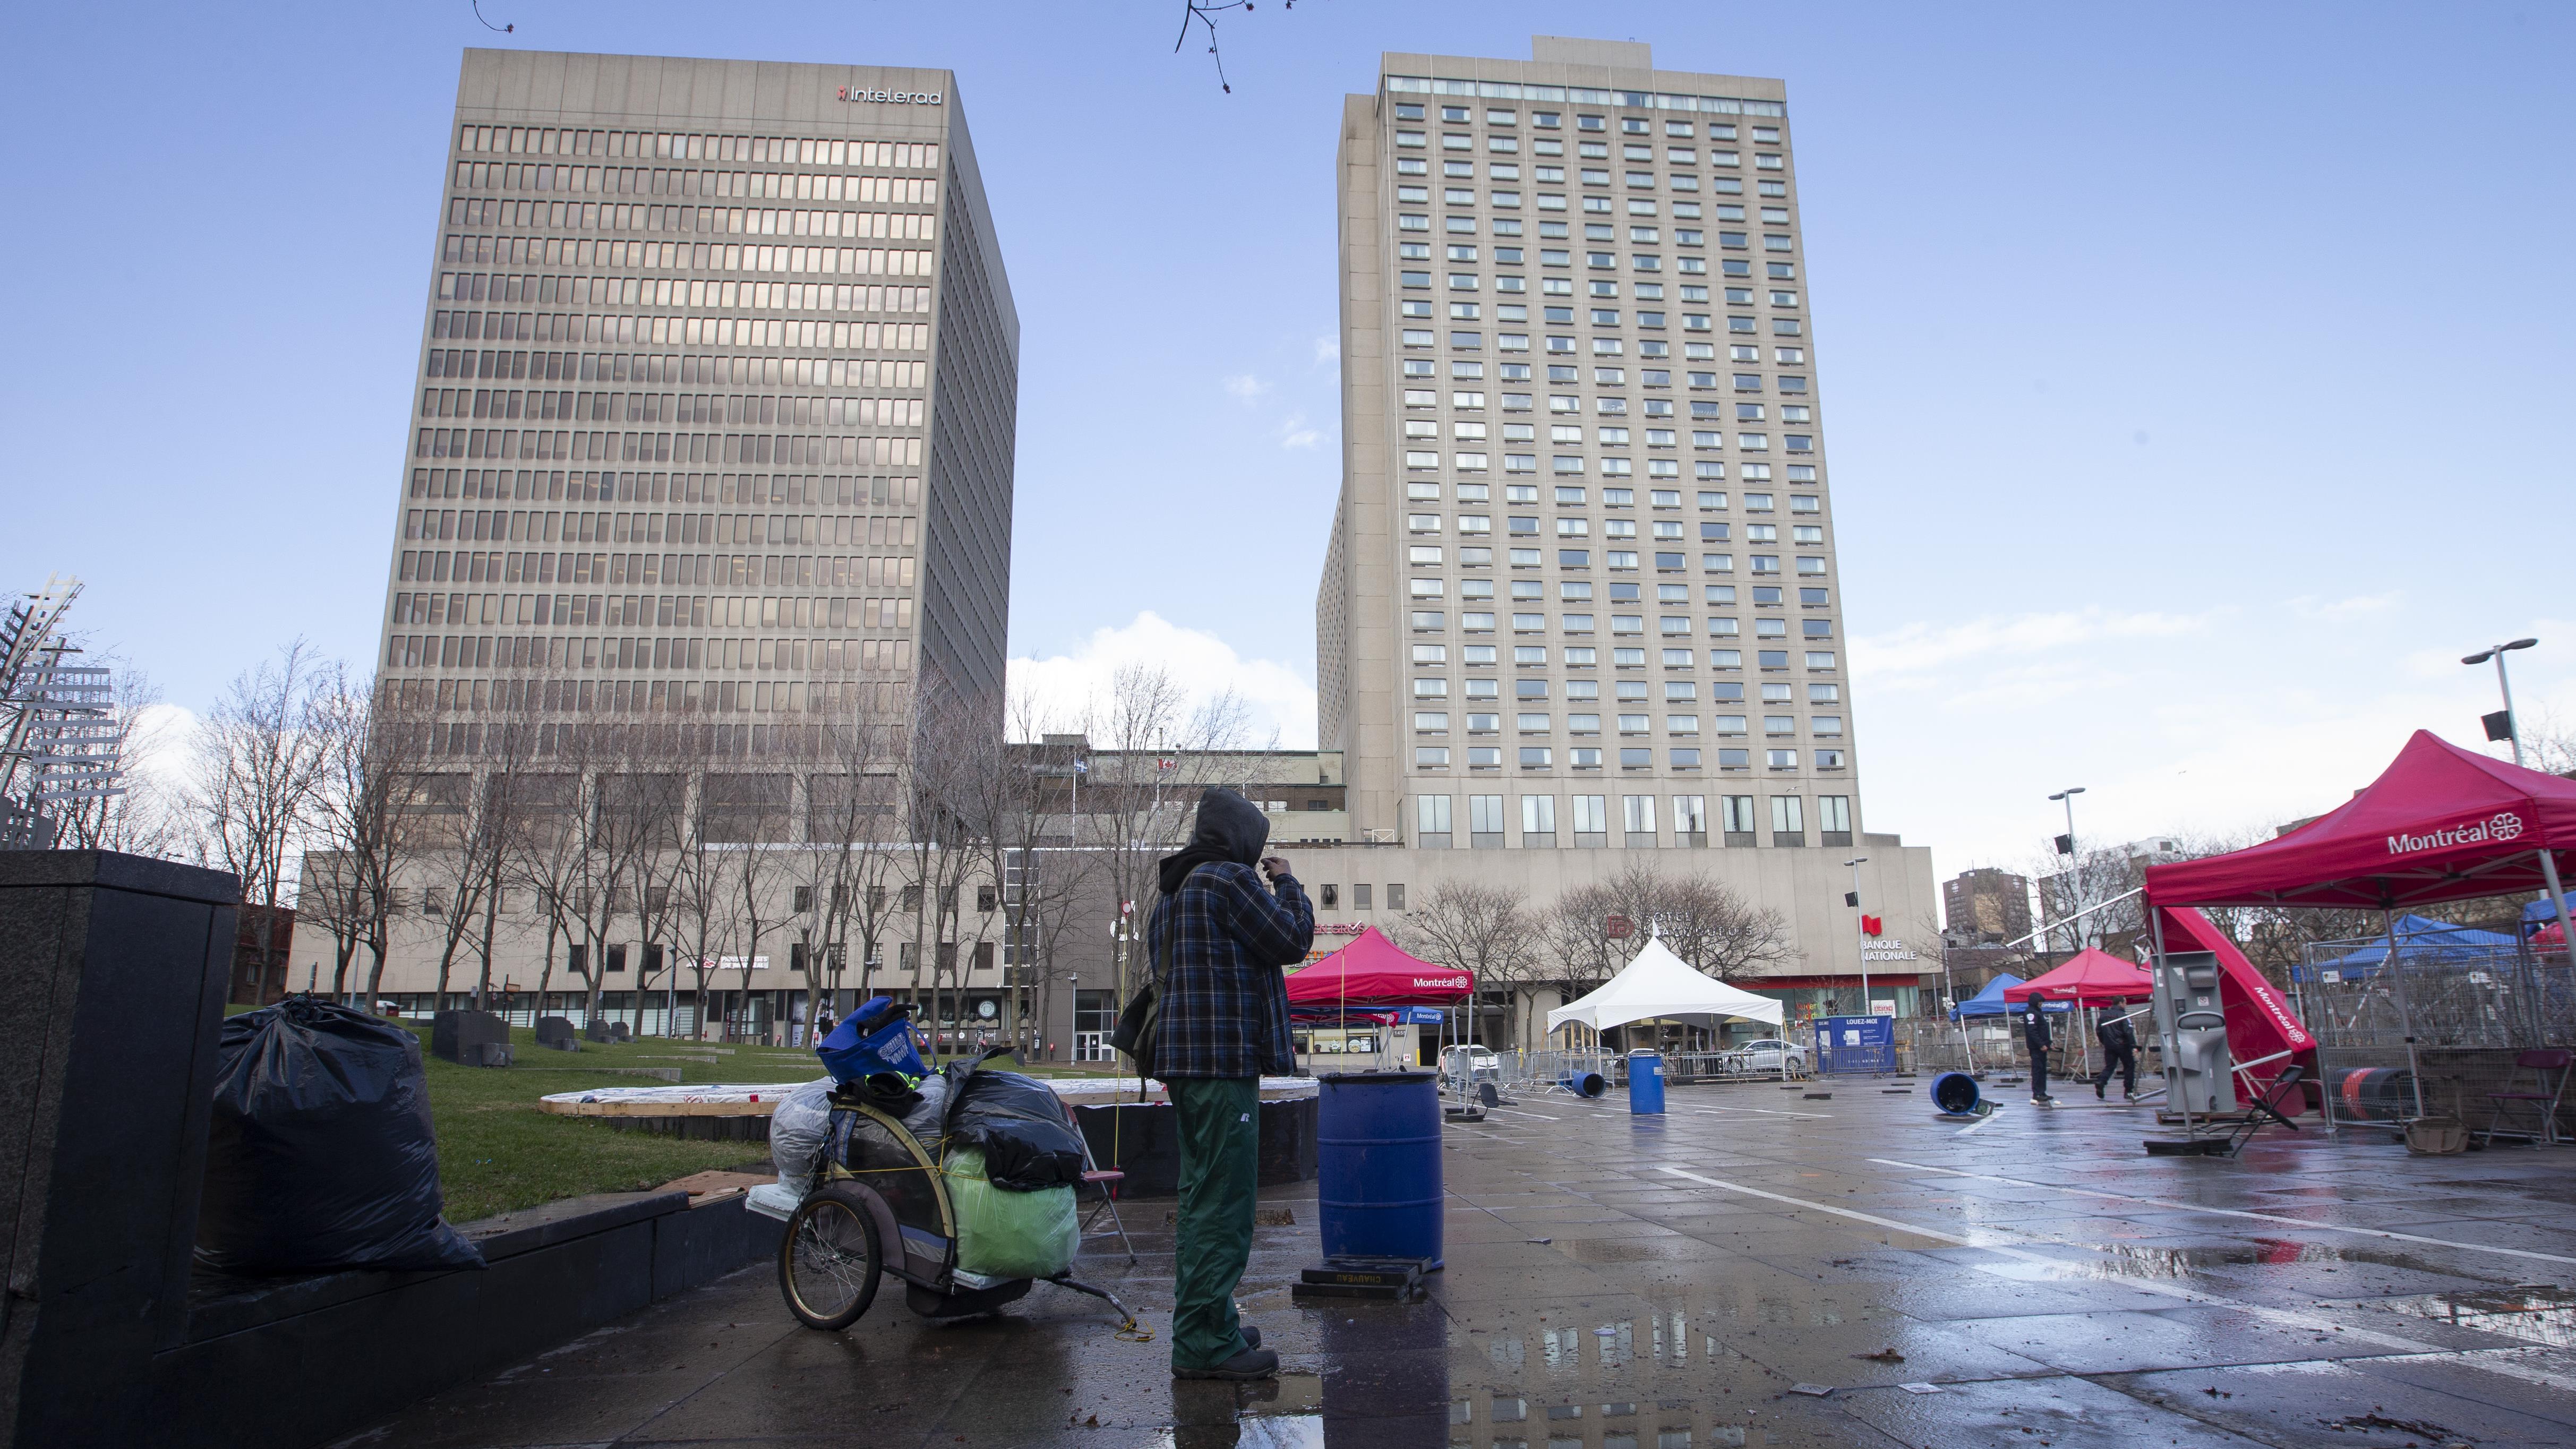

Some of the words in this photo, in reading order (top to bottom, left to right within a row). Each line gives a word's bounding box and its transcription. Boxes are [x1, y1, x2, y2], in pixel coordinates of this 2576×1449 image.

[851, 85, 942, 105] Intelerad
[2387, 821, 2489, 854] Montréal
[1860, 939, 1902, 950] BANQUE
[1861, 951, 1917, 961] NATIONALE
[1414, 978, 1454, 987] Montréal
[2254, 987, 2295, 1029] Montréal
